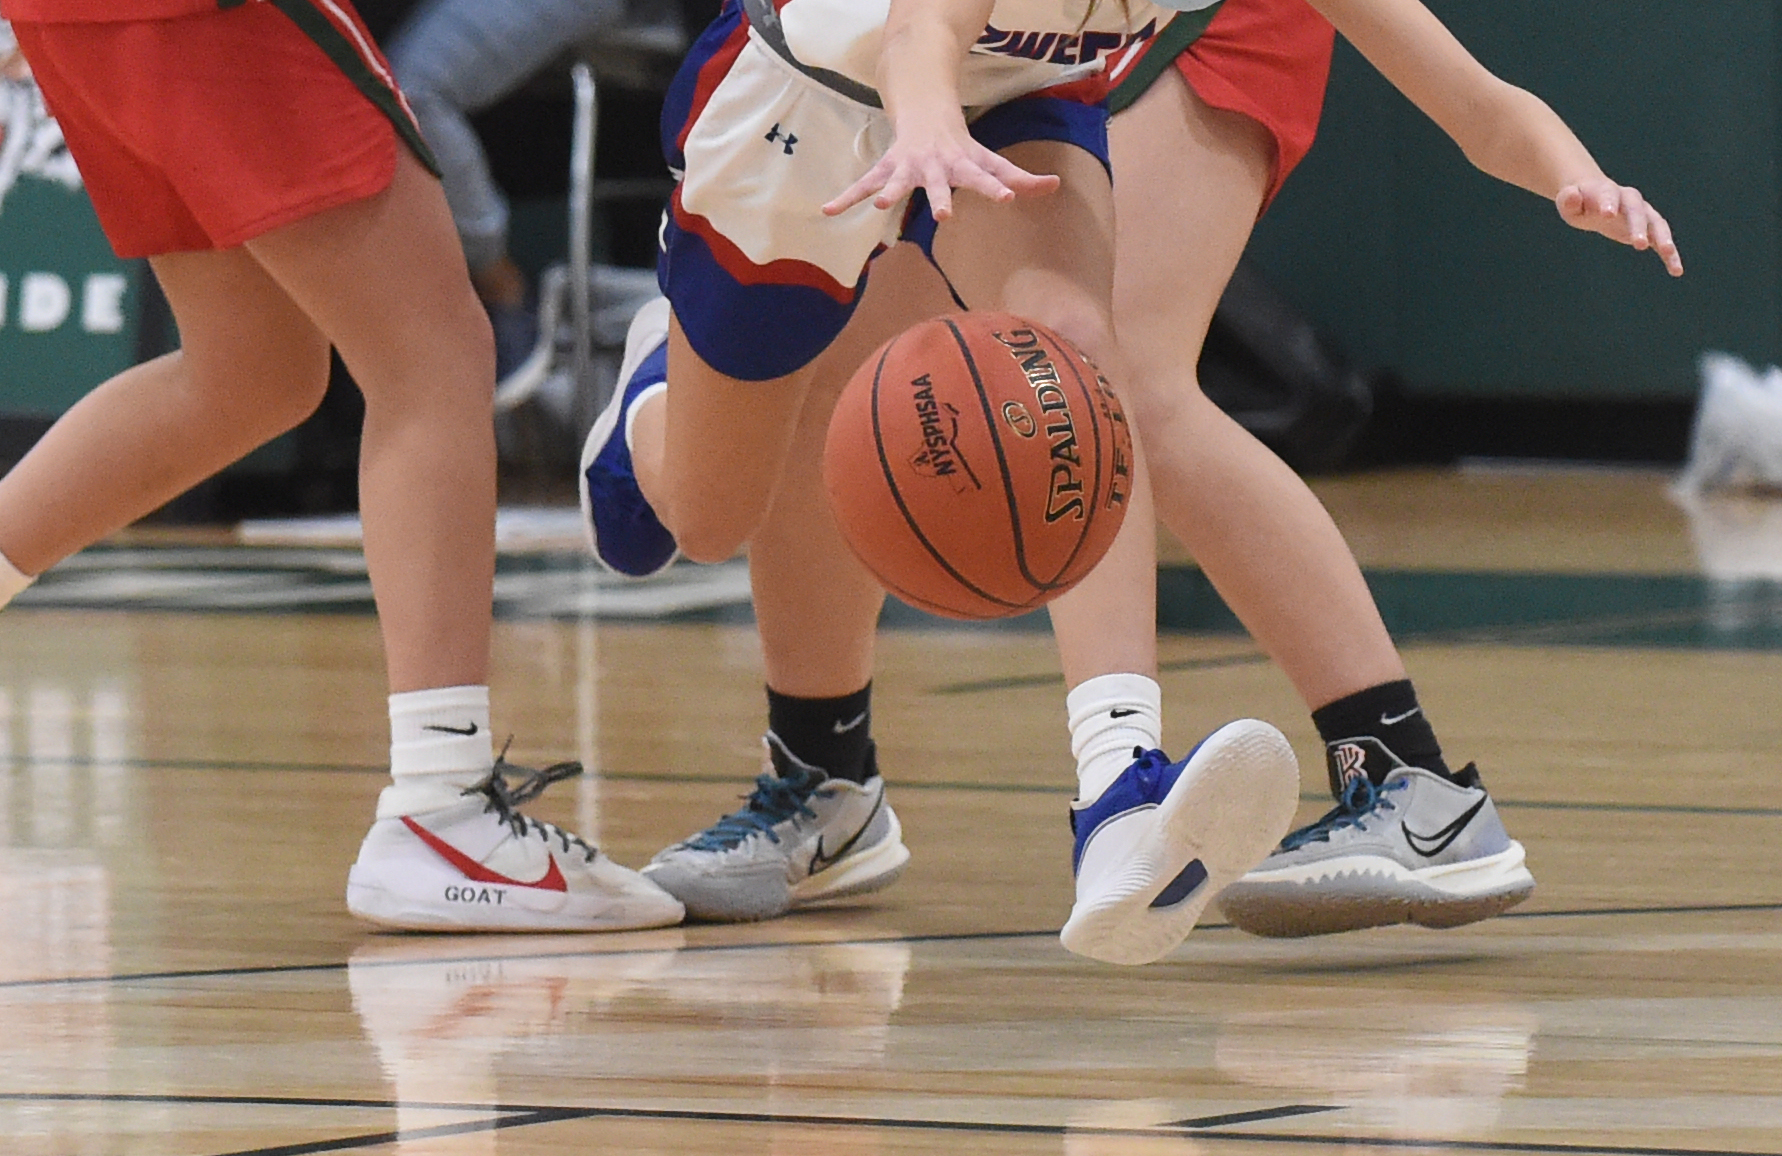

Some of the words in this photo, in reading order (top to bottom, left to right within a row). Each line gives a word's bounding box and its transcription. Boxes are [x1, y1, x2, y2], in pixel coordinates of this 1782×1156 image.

[910, 372, 957, 477] NYSPHSAA
[992, 326, 1085, 524] SPALDING
[444, 885, 507, 905] GOAT
